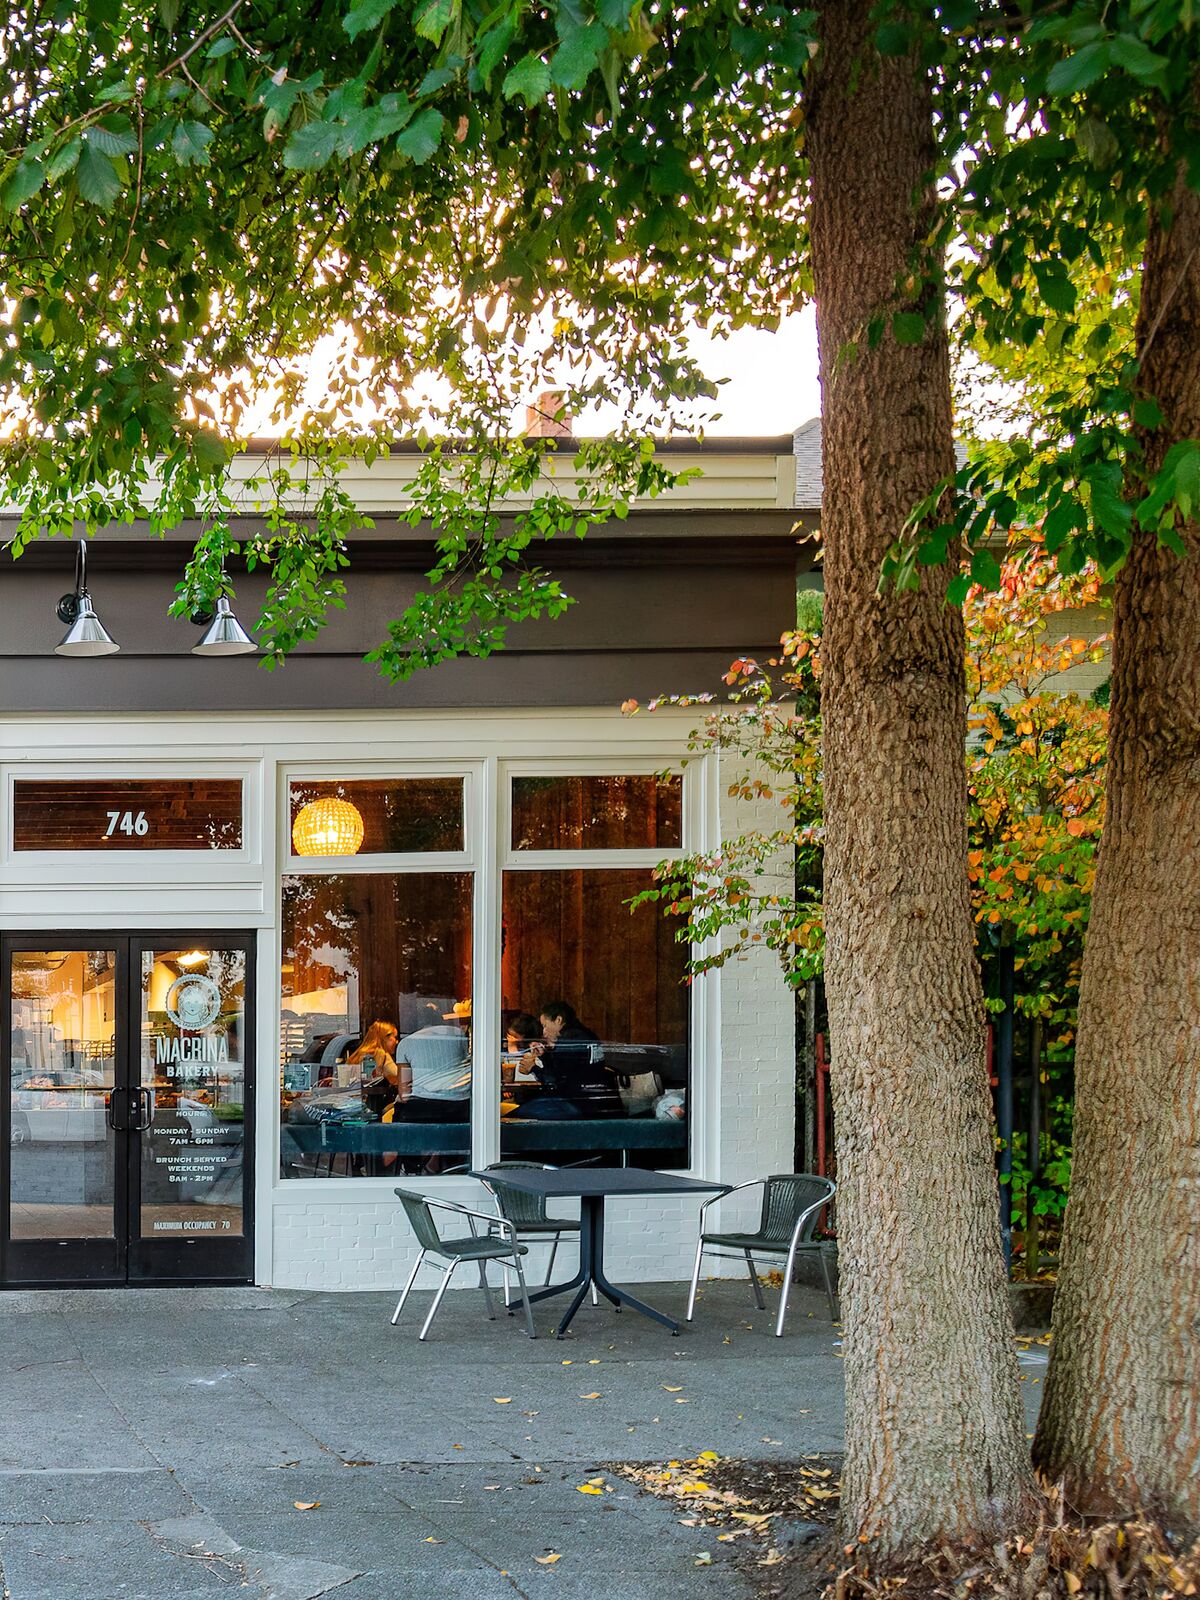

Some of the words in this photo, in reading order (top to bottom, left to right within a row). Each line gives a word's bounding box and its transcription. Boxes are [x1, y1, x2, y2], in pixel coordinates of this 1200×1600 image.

[106, 811, 149, 836] 746
[156, 1036, 229, 1064] MACRINA
[166, 1066, 218, 1077] BAKERY
[195, 1127, 230, 1135] SUNDAY
[221, 1220, 231, 1229] 70
